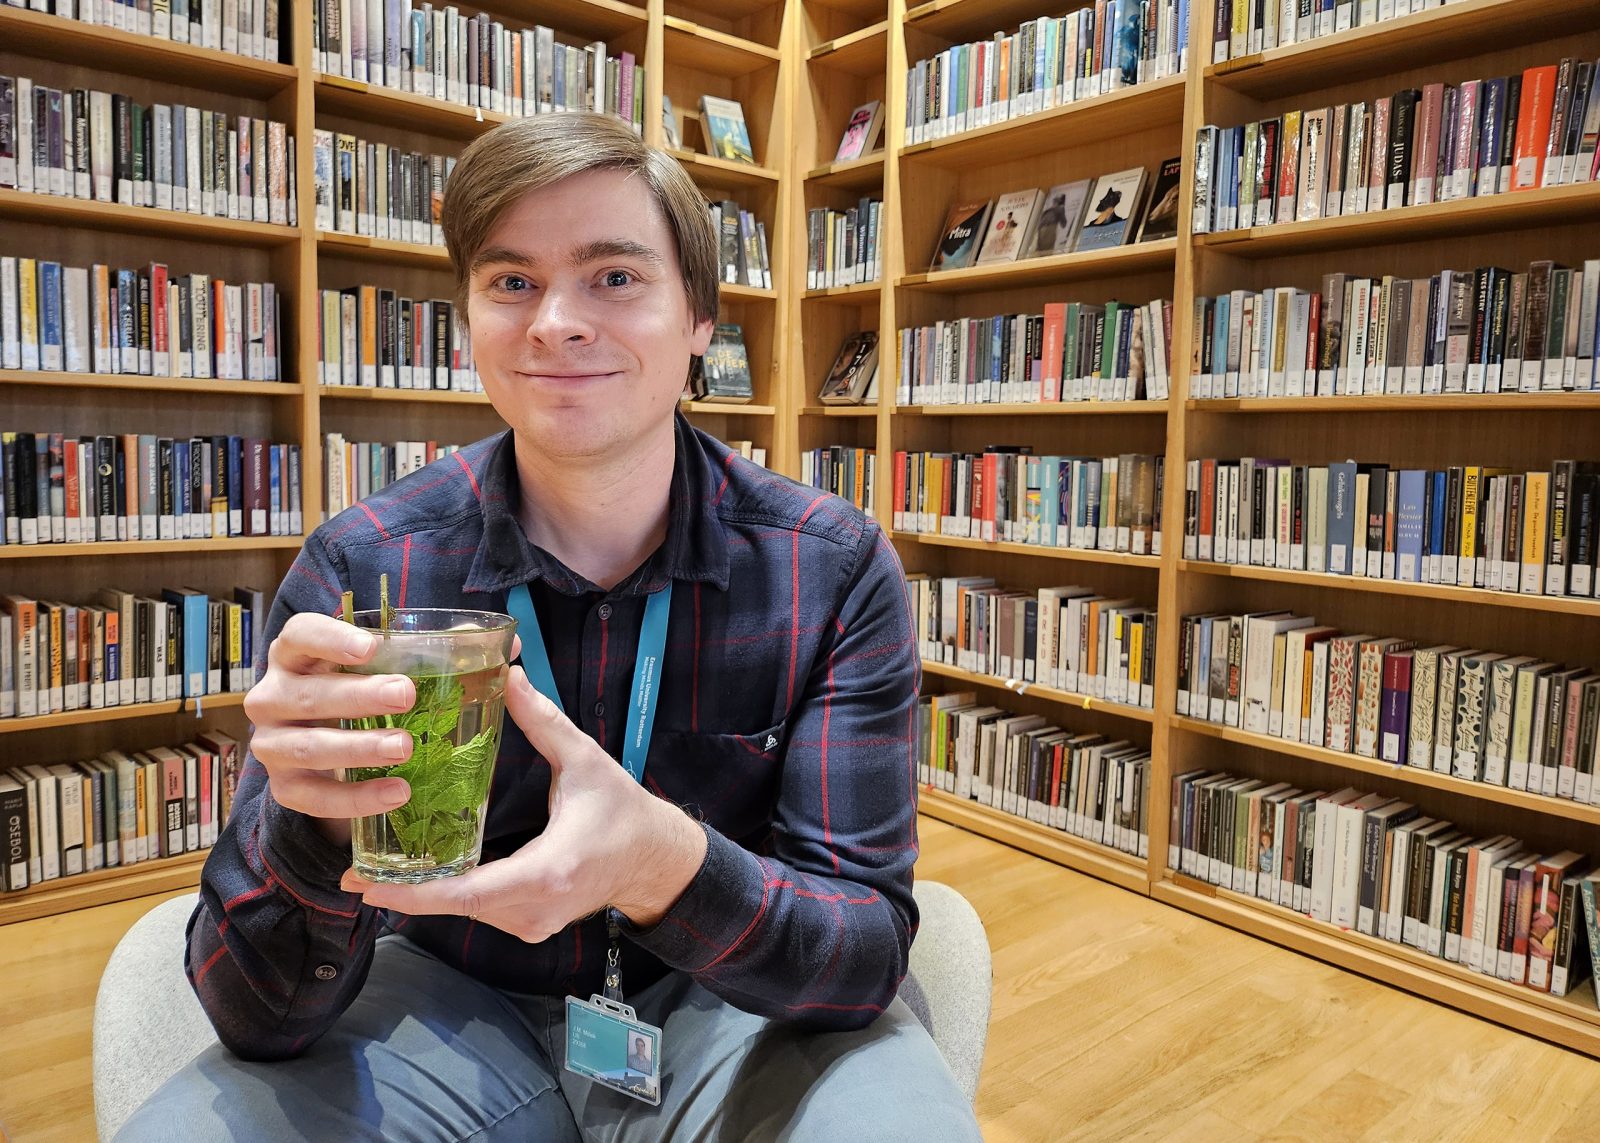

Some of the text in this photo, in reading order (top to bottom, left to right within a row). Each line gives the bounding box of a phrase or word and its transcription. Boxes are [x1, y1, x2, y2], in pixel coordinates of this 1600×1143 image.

[1393, 142, 1405, 168] JUDAS
[948, 226, 972, 240] Mitra
[1480, 272, 1488, 290] YVES
[1456, 298, 1464, 320] PETRY
[1478, 290, 1486, 312] PETRY
[706, 357, 747, 370] RIVIER
[1464, 474, 1478, 515] BUITENLEVEN
[1552, 491, 1565, 563] IN DE SCHADUW VAN DE
[635, 656, 656, 748] Erasmus University Rotterdam
[9, 816, 22, 863] OSEBOL
[1584, 888, 1594, 924] Andrew
